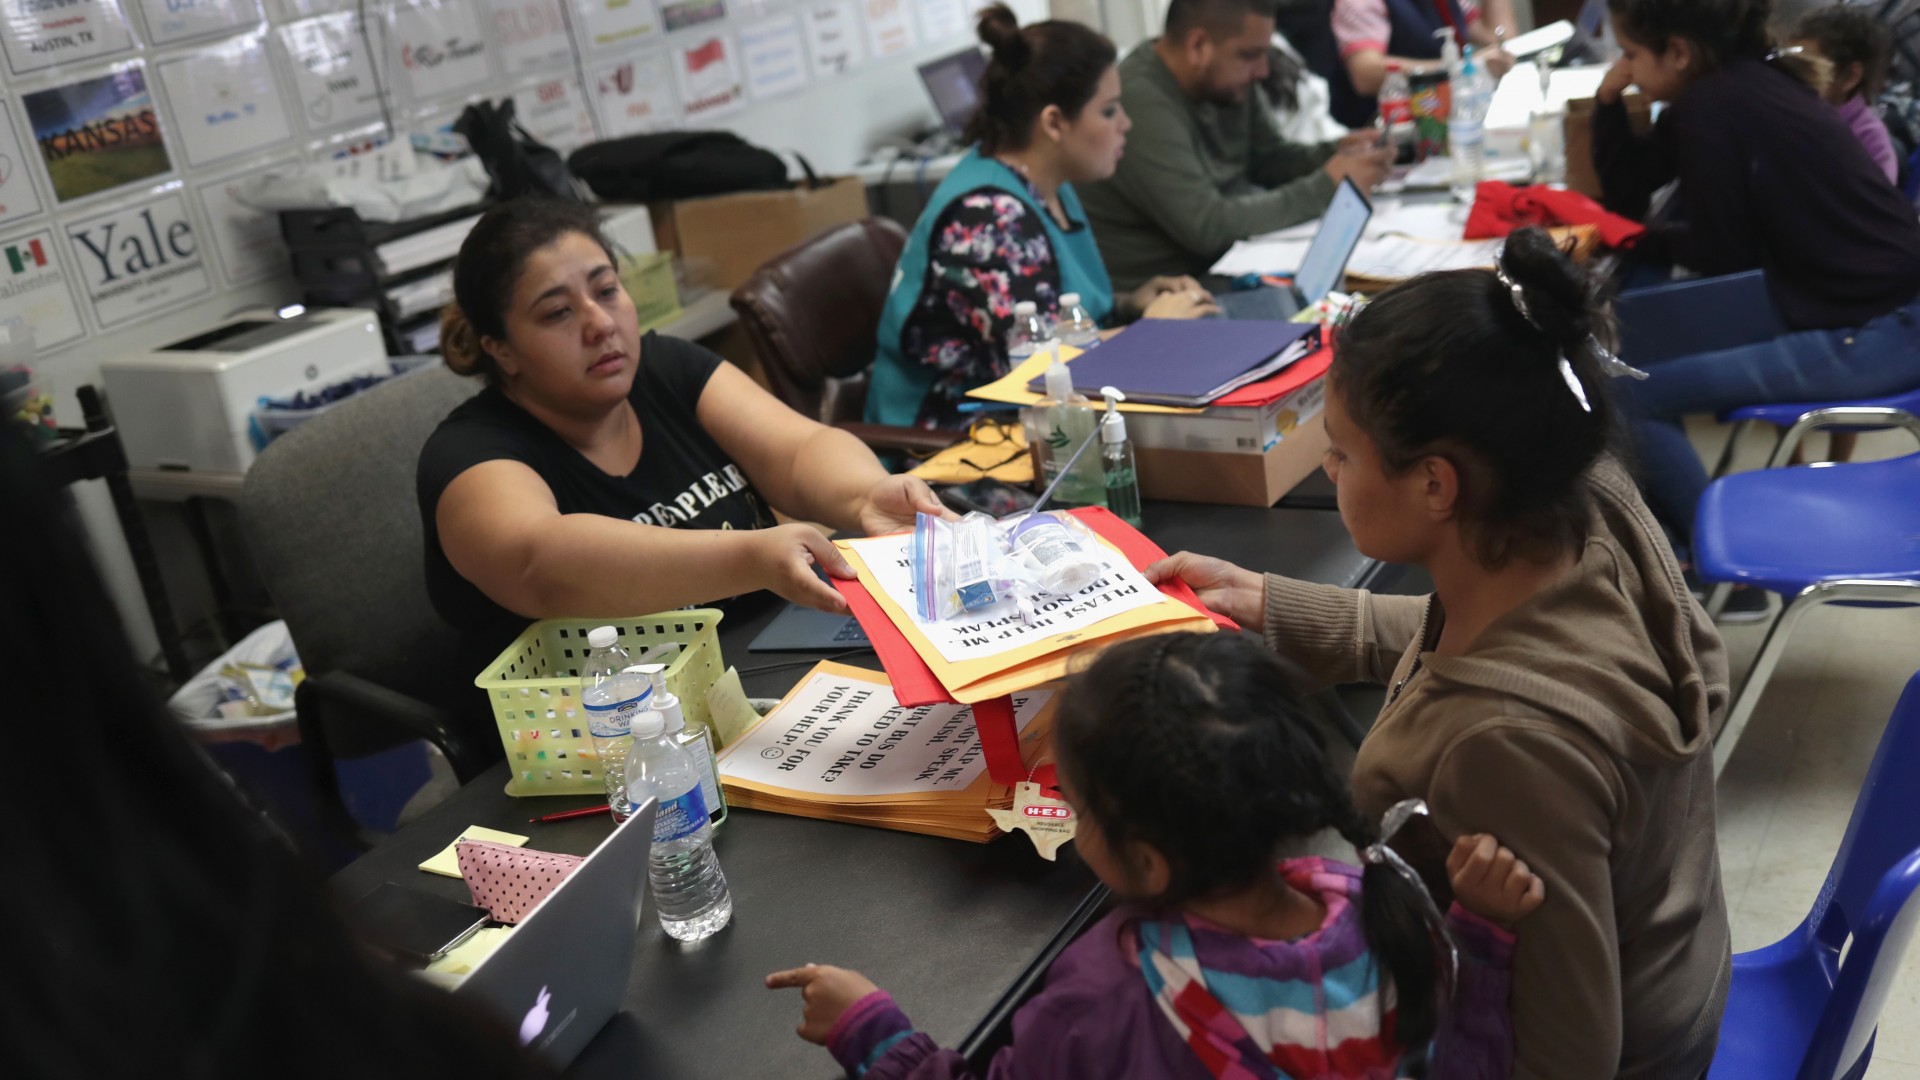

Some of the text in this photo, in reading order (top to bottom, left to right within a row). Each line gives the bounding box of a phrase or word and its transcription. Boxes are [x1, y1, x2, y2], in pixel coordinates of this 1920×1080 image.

[41, 110, 156, 161] KANSAS
[70, 206, 198, 285] Yale
[0, 270, 62, 300] alientes
[1079, 577, 1111, 595] DO
[1059, 584, 1139, 620] PLEASE
[998, 618, 1054, 639] HELP
[949, 636, 990, 647] ME.
[609, 705, 649, 724] DRINKING
[776, 686, 851, 746] YOUR HELP!
[925, 703, 973, 746] NGLISH.
[777, 690, 874, 772] THANK YOU FOR
[856, 732, 881, 747] TO
[877, 729, 910, 751] BUS
[859, 753, 886, 769] DO
[914, 724, 978, 781] NOT SPEAK
[821, 749, 865, 783] TAKE?
[933, 767, 964, 785] ME.
[655, 800, 678, 818] land
[1027, 807, 1067, 817] H-E-B
